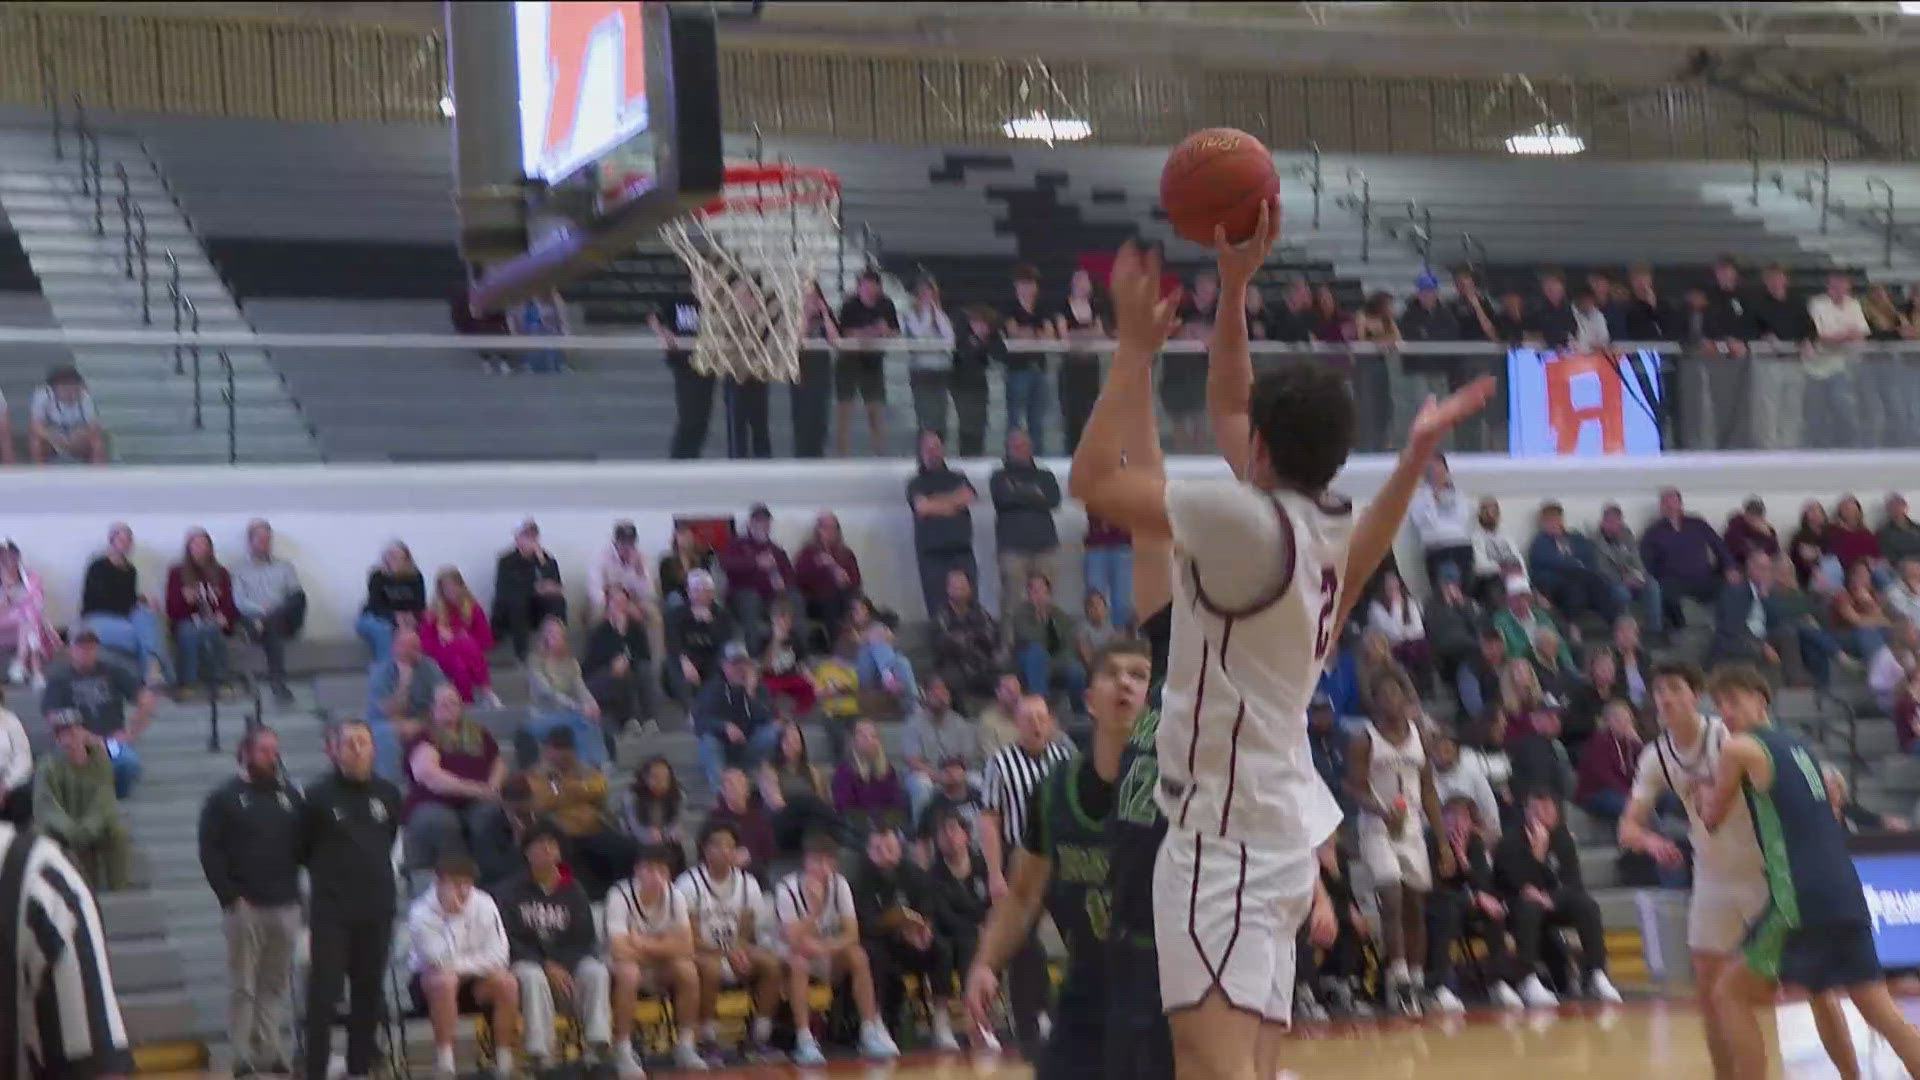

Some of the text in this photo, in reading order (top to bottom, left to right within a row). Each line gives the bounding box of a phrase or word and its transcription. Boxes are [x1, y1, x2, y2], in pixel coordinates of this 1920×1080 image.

[1545, 352, 1625, 456] A
[1314, 564, 1338, 661] 2
[1117, 754, 1158, 828] 12
